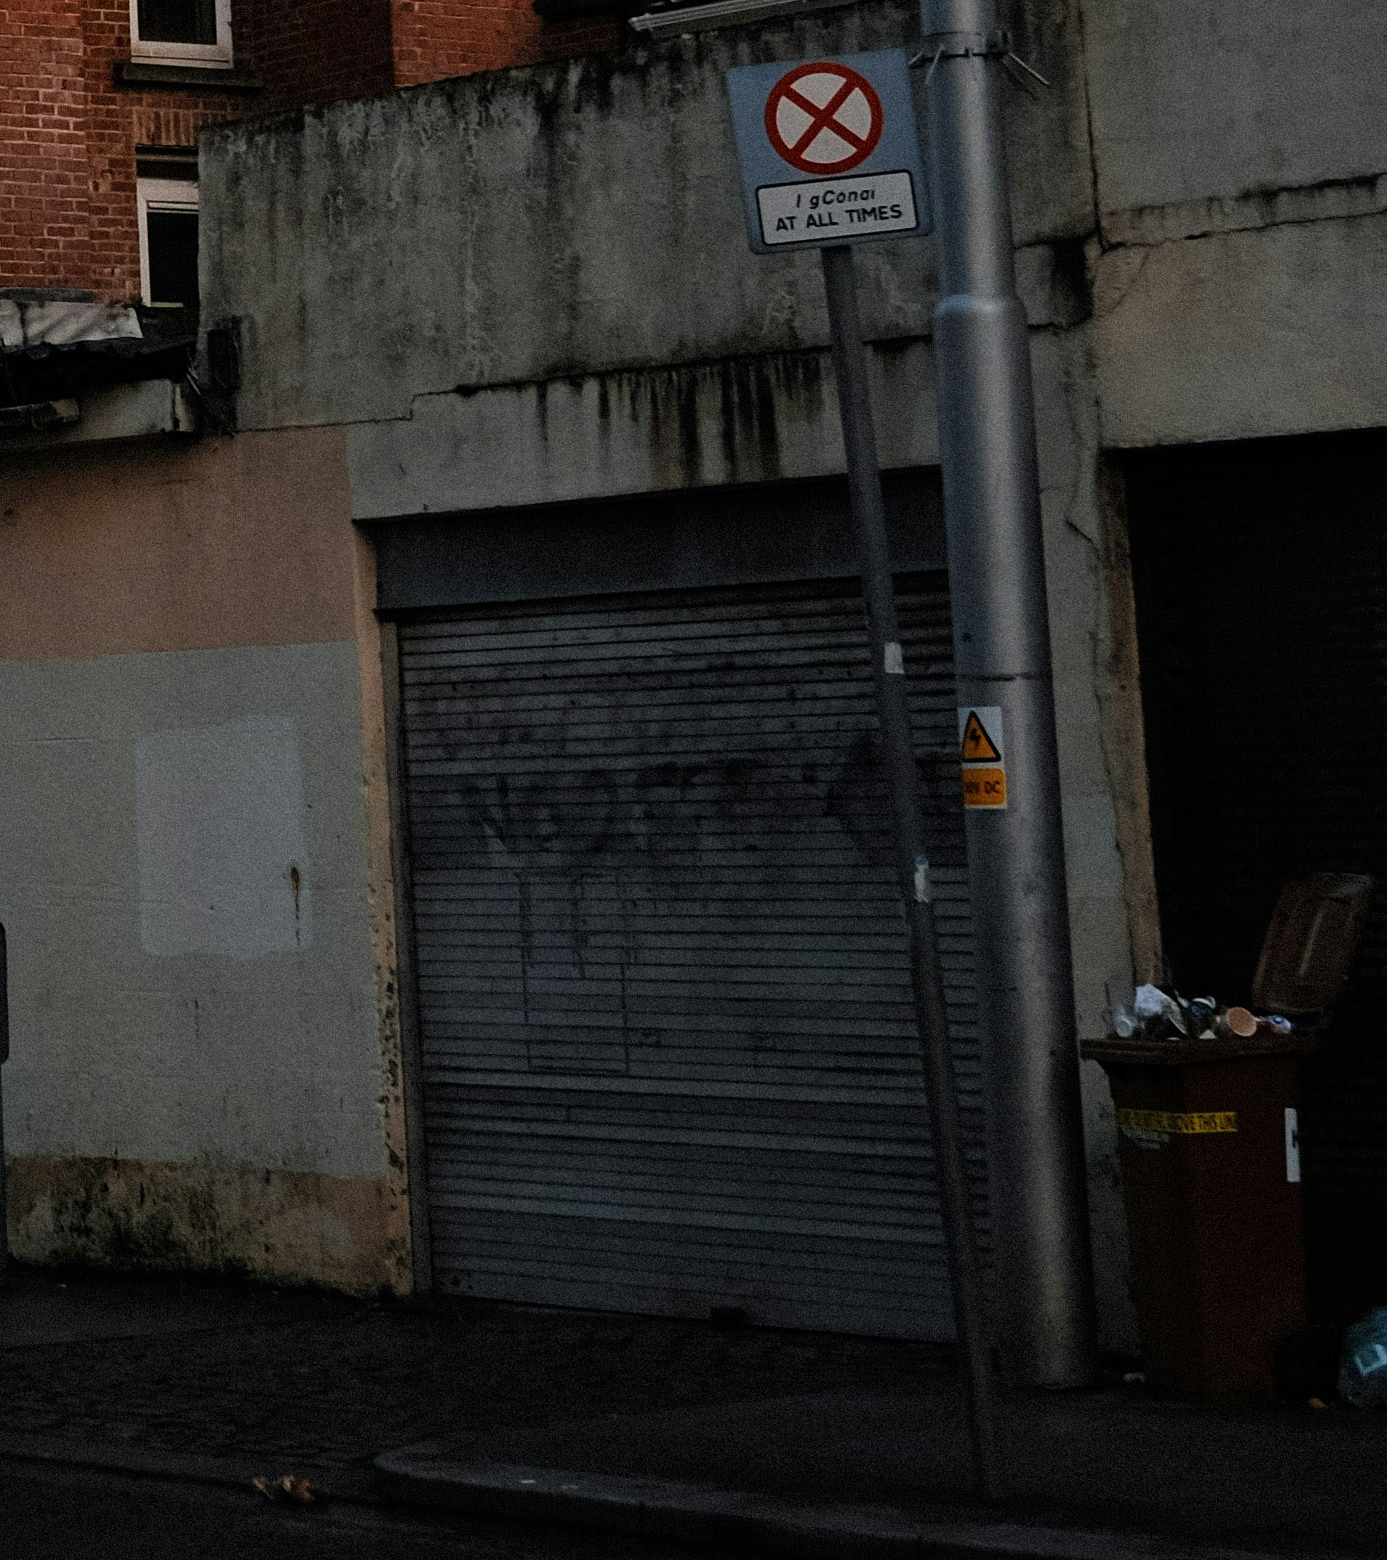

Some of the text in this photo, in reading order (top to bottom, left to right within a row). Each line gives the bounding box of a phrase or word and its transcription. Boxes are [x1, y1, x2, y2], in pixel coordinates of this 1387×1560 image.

[776, 203, 903, 232] AT ALL TIMES
